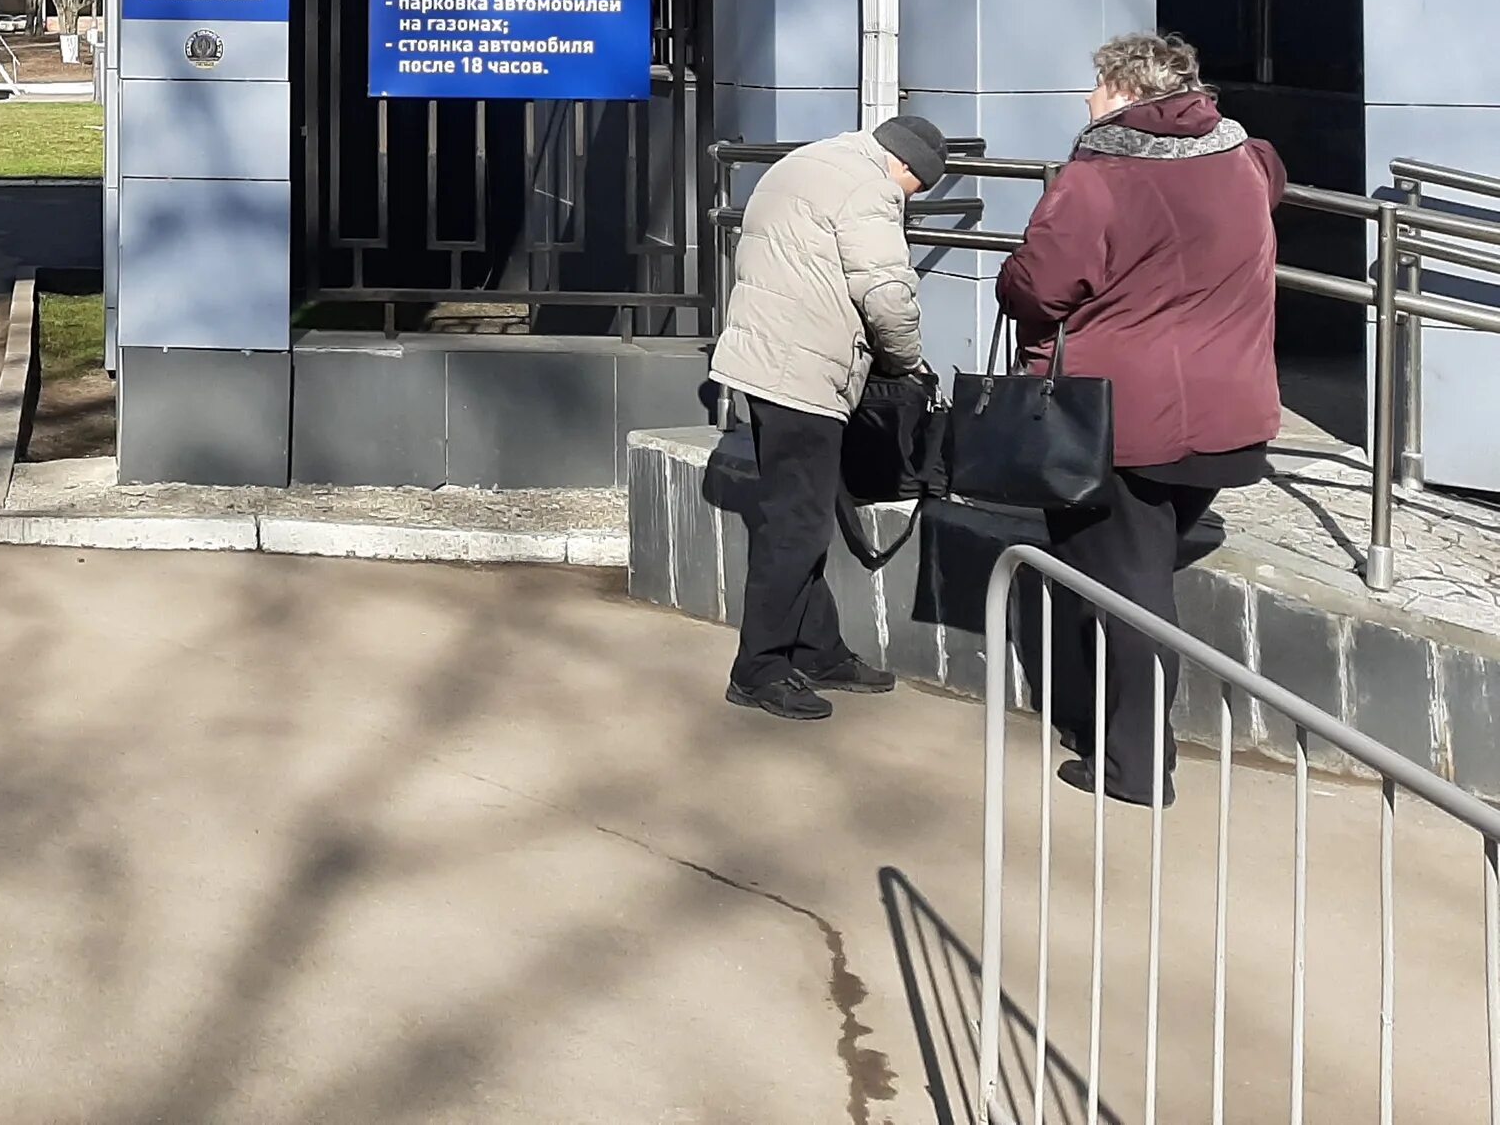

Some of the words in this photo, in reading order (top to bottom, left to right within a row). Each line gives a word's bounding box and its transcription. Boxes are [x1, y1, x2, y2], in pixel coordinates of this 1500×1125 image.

[399, 18, 421, 31] на
[427, 18, 509, 34] газонах;
[398, 38, 473, 52] стоянка
[478, 36, 595, 53] автомобиля
[399, 59, 455, 73] после
[461, 56, 483, 73] 18
[487, 60, 549, 74] часов.
